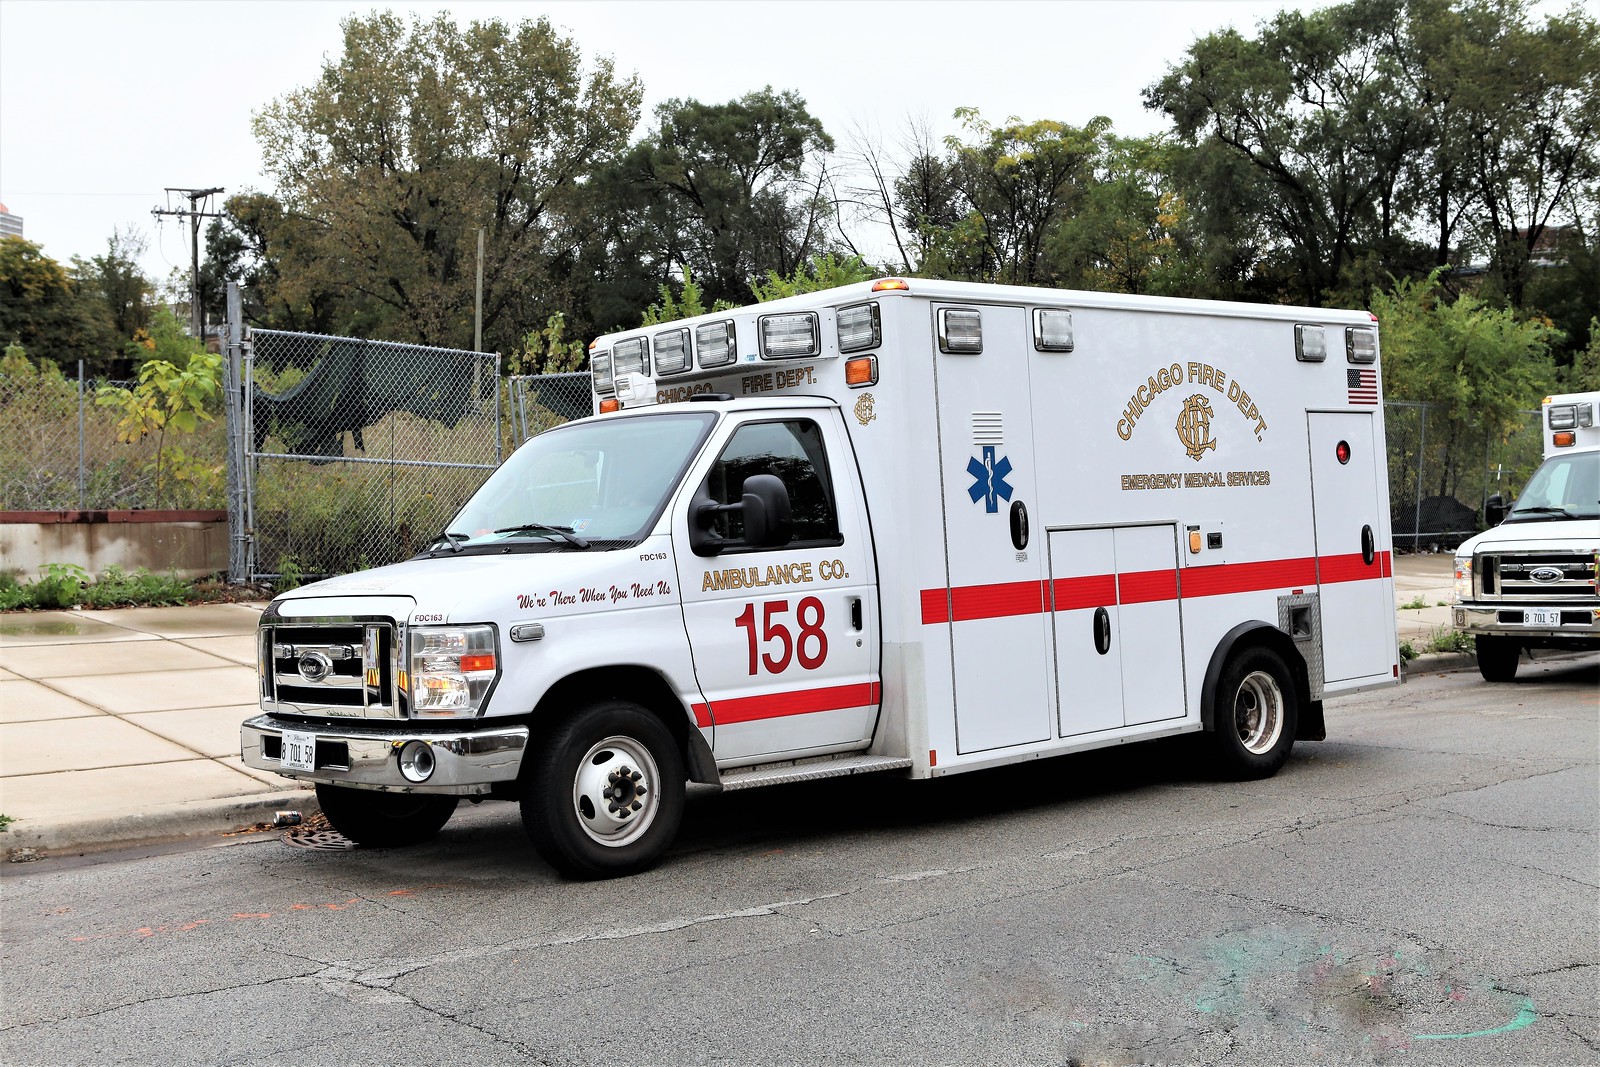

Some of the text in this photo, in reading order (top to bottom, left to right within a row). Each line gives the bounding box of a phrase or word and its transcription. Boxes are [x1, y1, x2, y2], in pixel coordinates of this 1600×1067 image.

[741, 373, 774, 394] FIRE
[776, 366, 818, 389] DEPT.
[1116, 361, 1268, 442] CHICAGO FIRE DEPT.
[1120, 470, 1271, 491] EMERGENCY MEDICAL SERVICES
[639, 552, 668, 562] FDC163
[702, 559, 850, 592] AMBULANCE CO.
[516, 580, 672, 609] We're There When You Need Us
[414, 614, 443, 622] FDC163
[1524, 613, 1559, 623] 8 701 57
[734, 596, 829, 676] 158
[281, 742, 314, 764] 8 701 58
